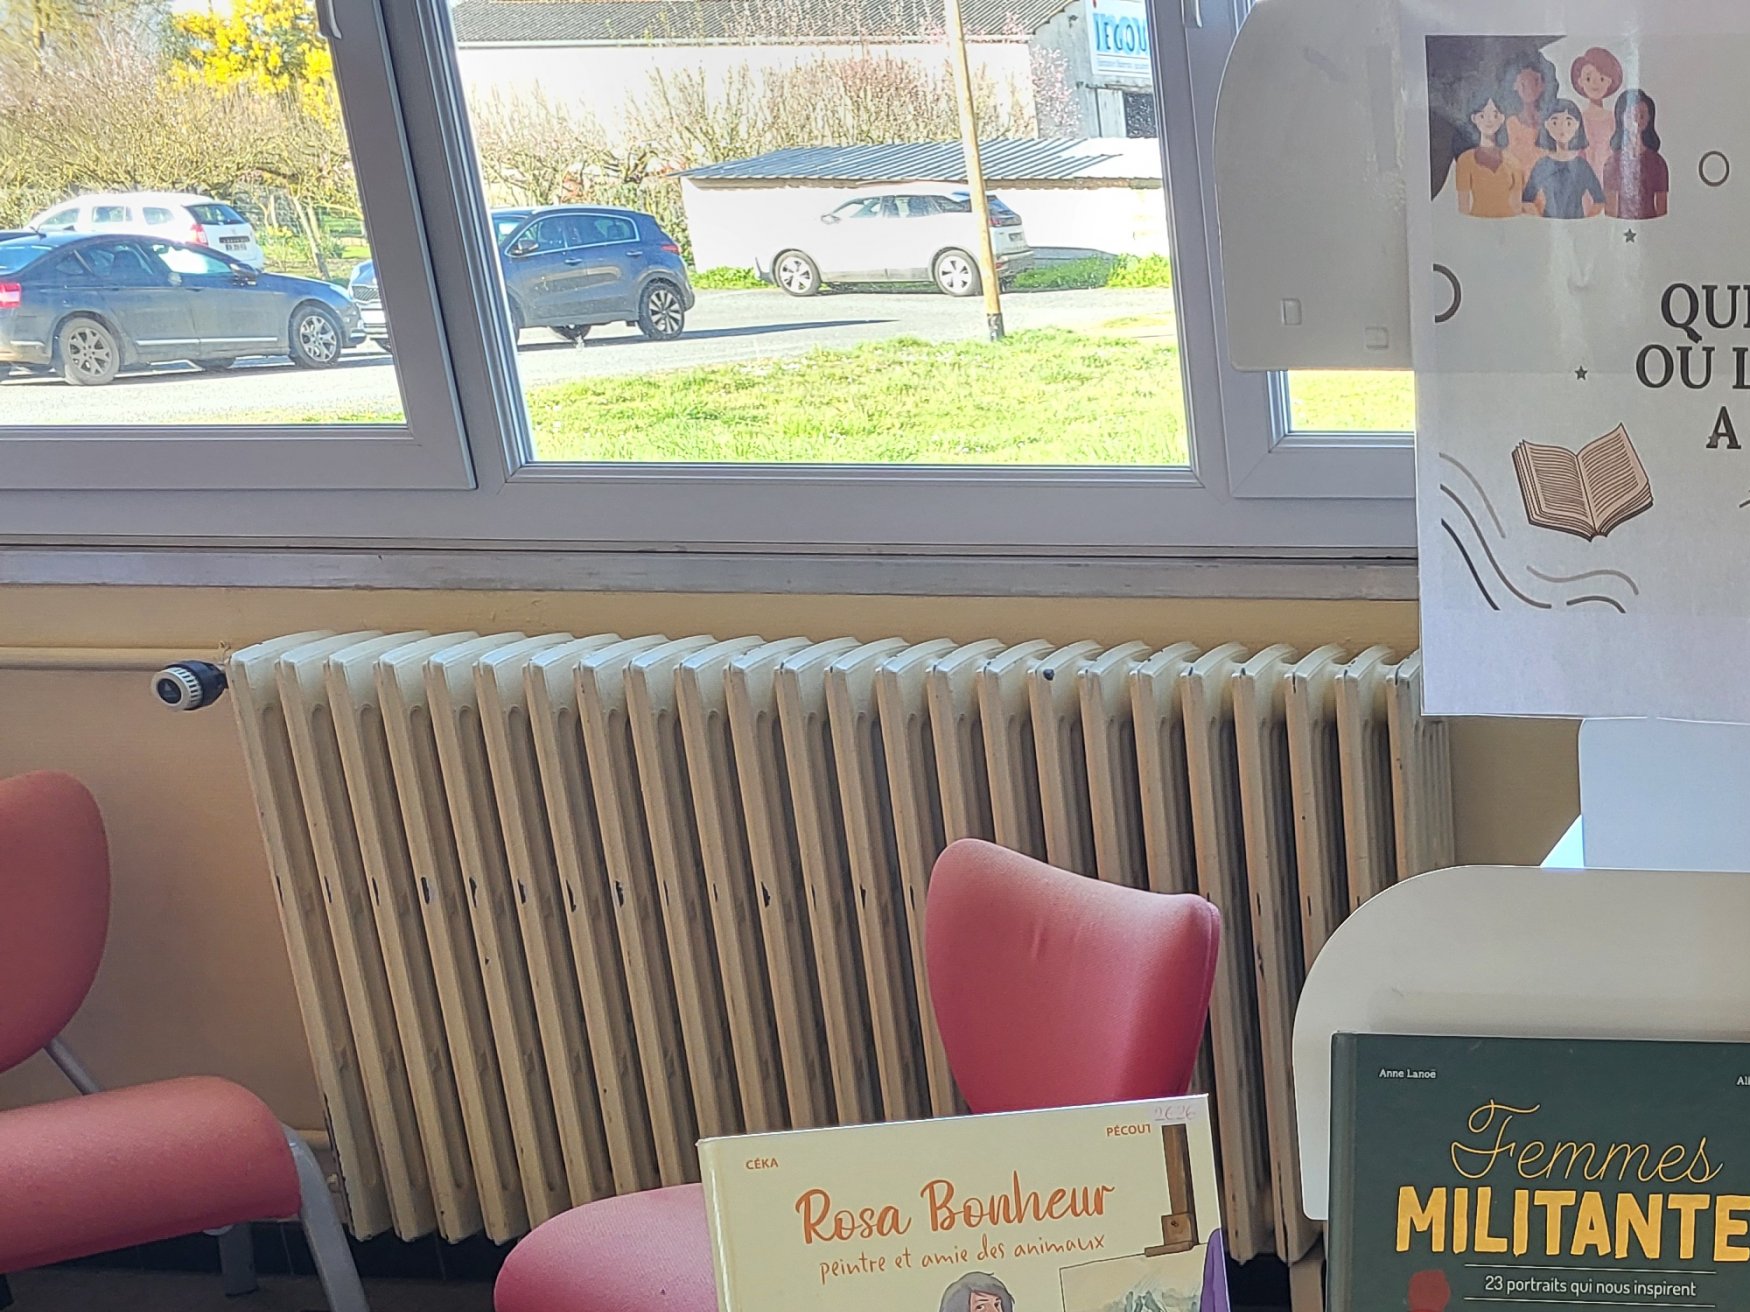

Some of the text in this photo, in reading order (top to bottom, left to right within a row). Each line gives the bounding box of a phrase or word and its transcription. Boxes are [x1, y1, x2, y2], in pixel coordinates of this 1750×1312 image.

[1635, 333, 1713, 392] OÙ
[1706, 409, 1742, 450] A
[1379, 1068, 1436, 1080] Anne Lanoë
[745, 1156, 779, 1171] CÉKA
[1450, 1099, 1724, 1183] Femmes
[795, 1170, 1116, 1244] Rosa Bonheur
[819, 1234, 1105, 1285] peintre et amie des animaux
[1484, 1276, 1696, 1298] 23 portraits qui nous inspirent
